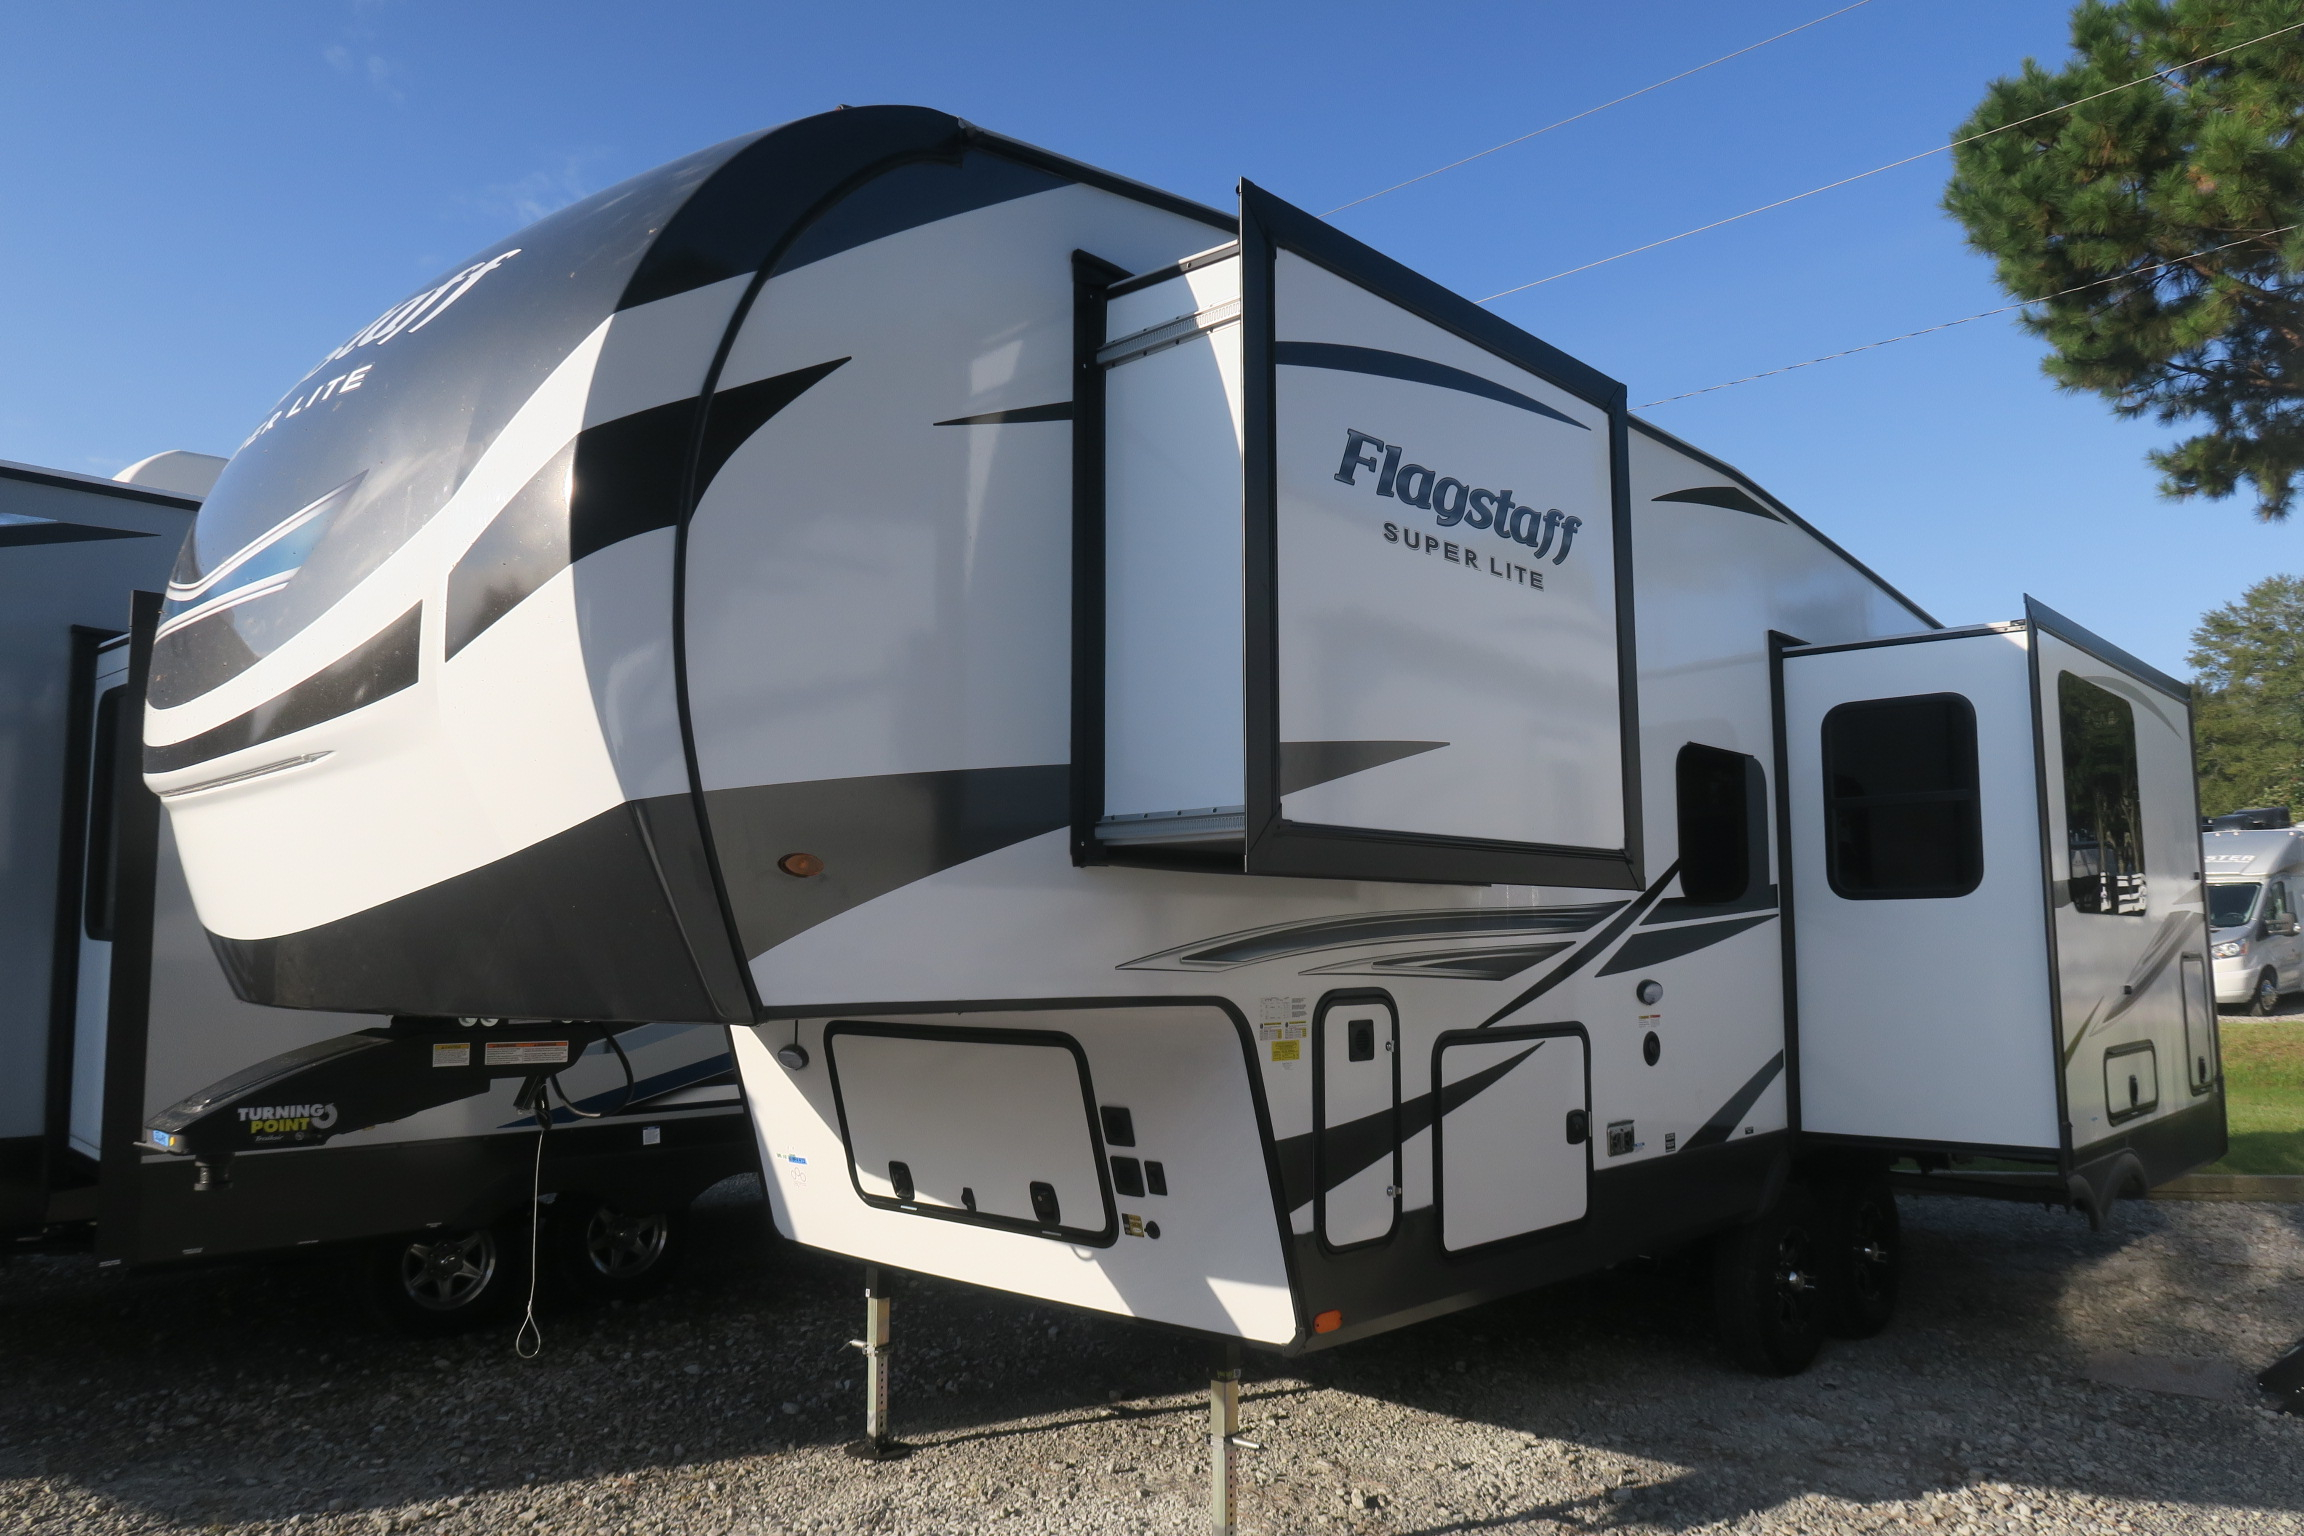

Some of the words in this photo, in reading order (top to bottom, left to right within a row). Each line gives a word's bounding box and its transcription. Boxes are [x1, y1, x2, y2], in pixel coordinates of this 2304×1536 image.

[285, 363, 374, 420] LITE
[1333, 427, 1583, 566] Flagstaff
[1382, 521, 1480, 571] SUPER
[1489, 556, 1544, 592] LITE
[237, 1103, 325, 1121] TURNING
[250, 1117, 310, 1134] POINT
